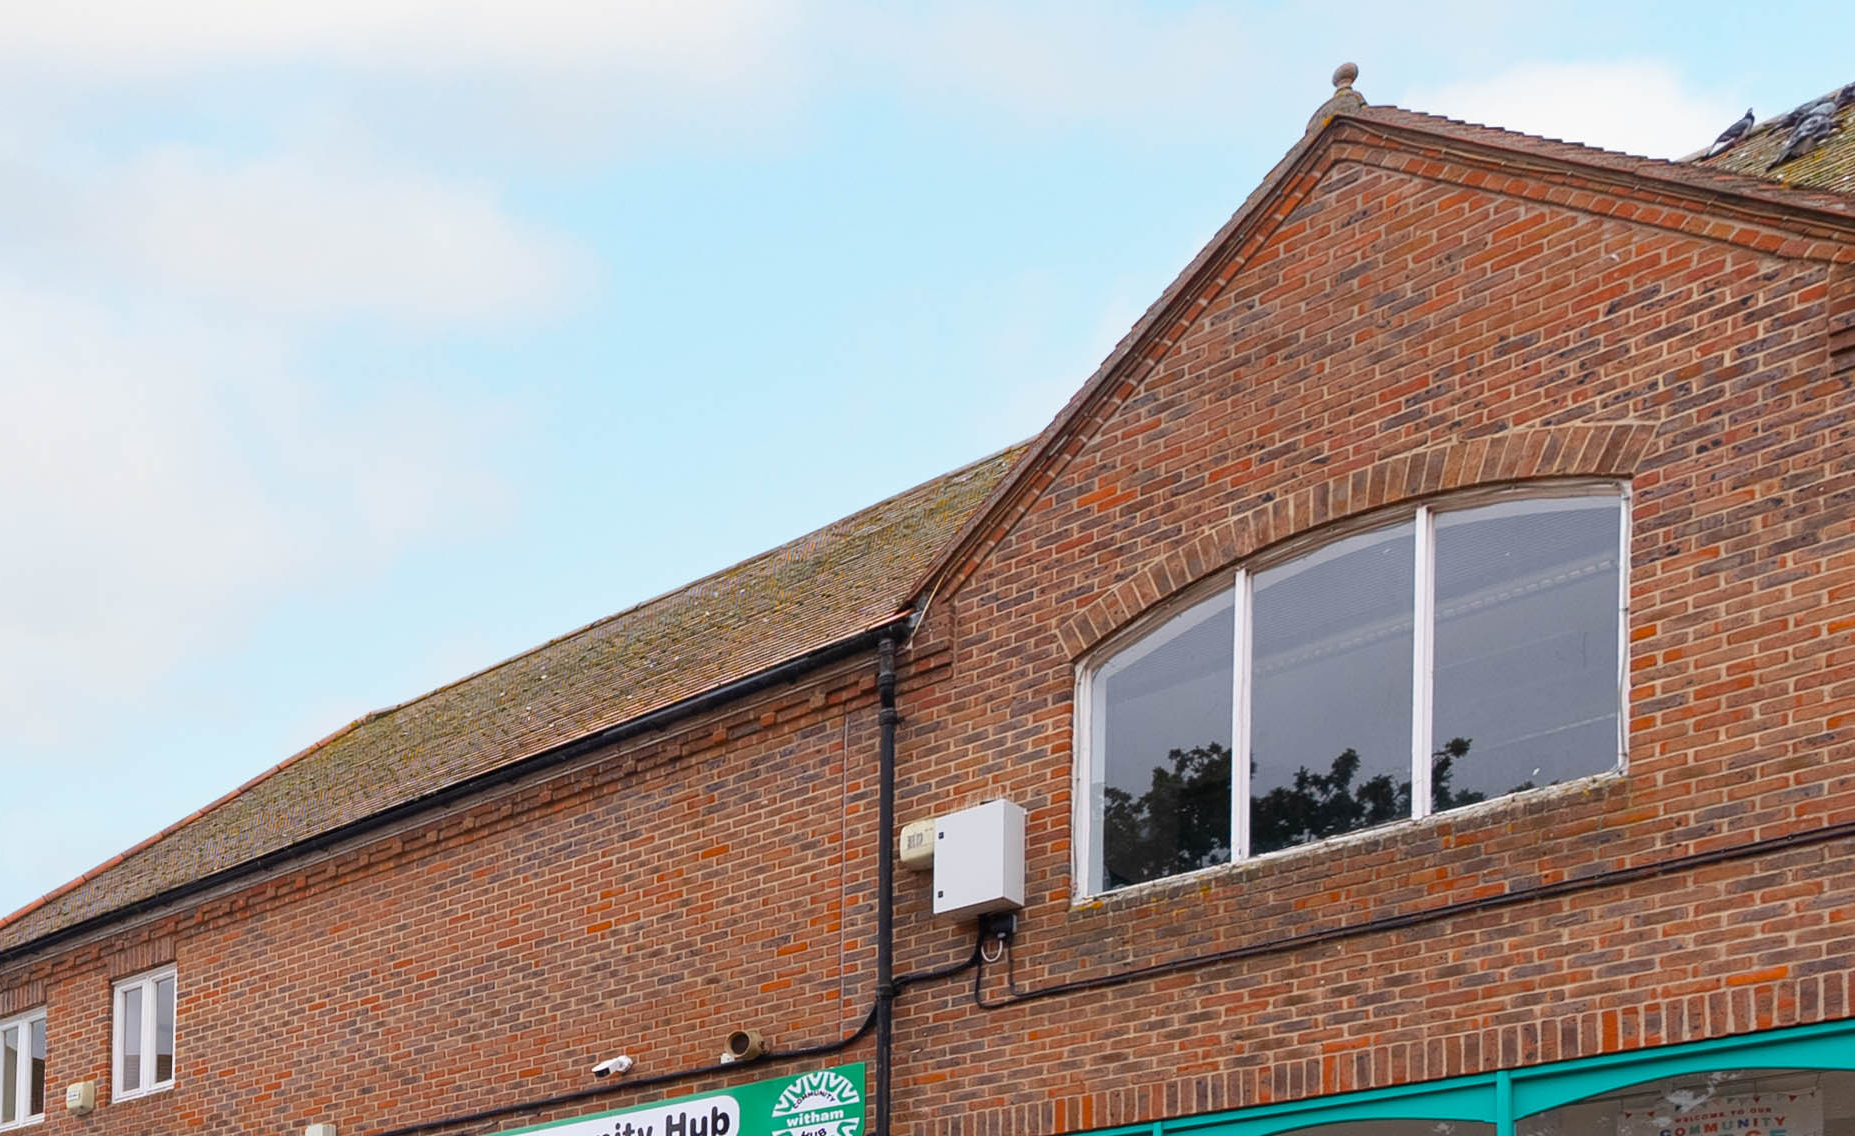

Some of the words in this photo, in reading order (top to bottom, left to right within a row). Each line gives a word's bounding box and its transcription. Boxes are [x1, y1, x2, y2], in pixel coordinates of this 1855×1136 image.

[792, 1090, 836, 1109] COMMUNITY
[786, 1109, 844, 1128] witham
[1674, 1111, 1726, 1124] WELCOME
[1730, 1108, 1745, 1116] TO
[1749, 1106, 1773, 1114] OUR
